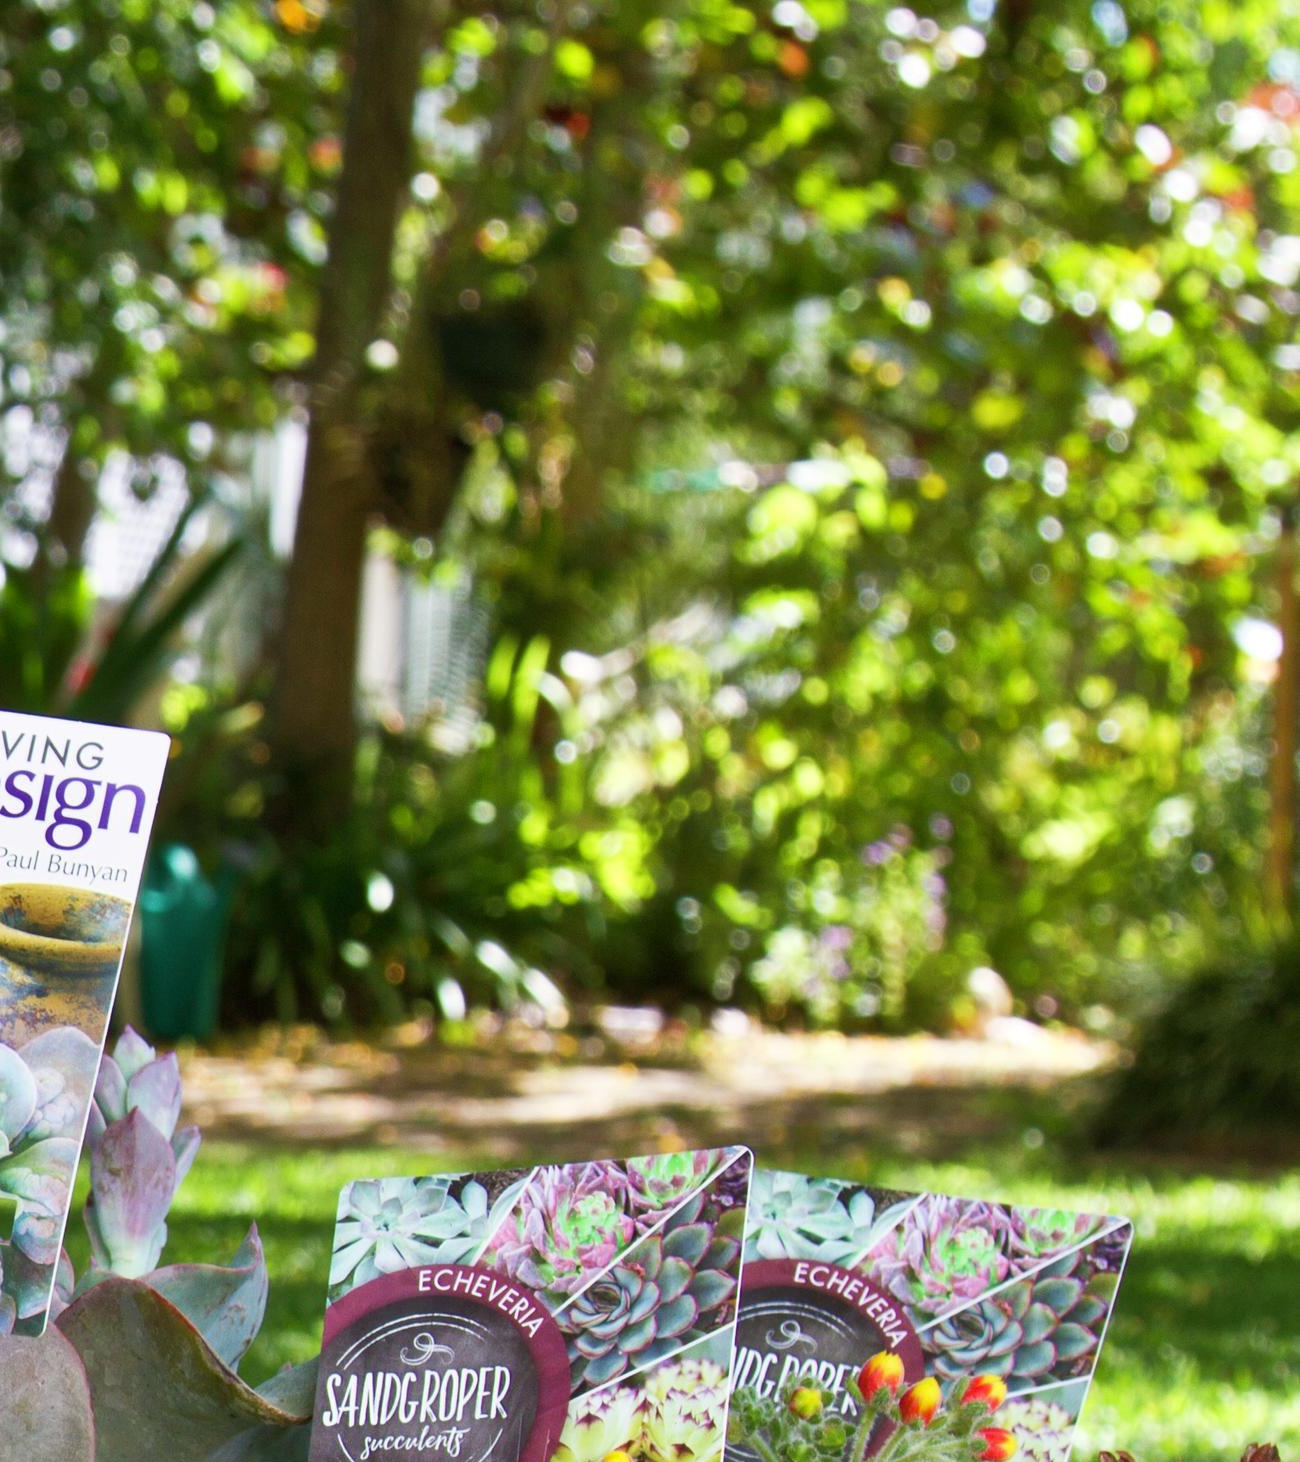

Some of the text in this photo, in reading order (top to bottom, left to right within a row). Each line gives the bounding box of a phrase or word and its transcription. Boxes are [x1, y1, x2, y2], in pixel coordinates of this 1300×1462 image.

[47, 855, 129, 886] Bunyan
[418, 1269, 545, 1338] ECHEVERIA
[792, 1262, 909, 1348] ECHEVERIA
[322, 1366, 512, 1428] SANDGROPER
[360, 1425, 471, 1460] succulents
